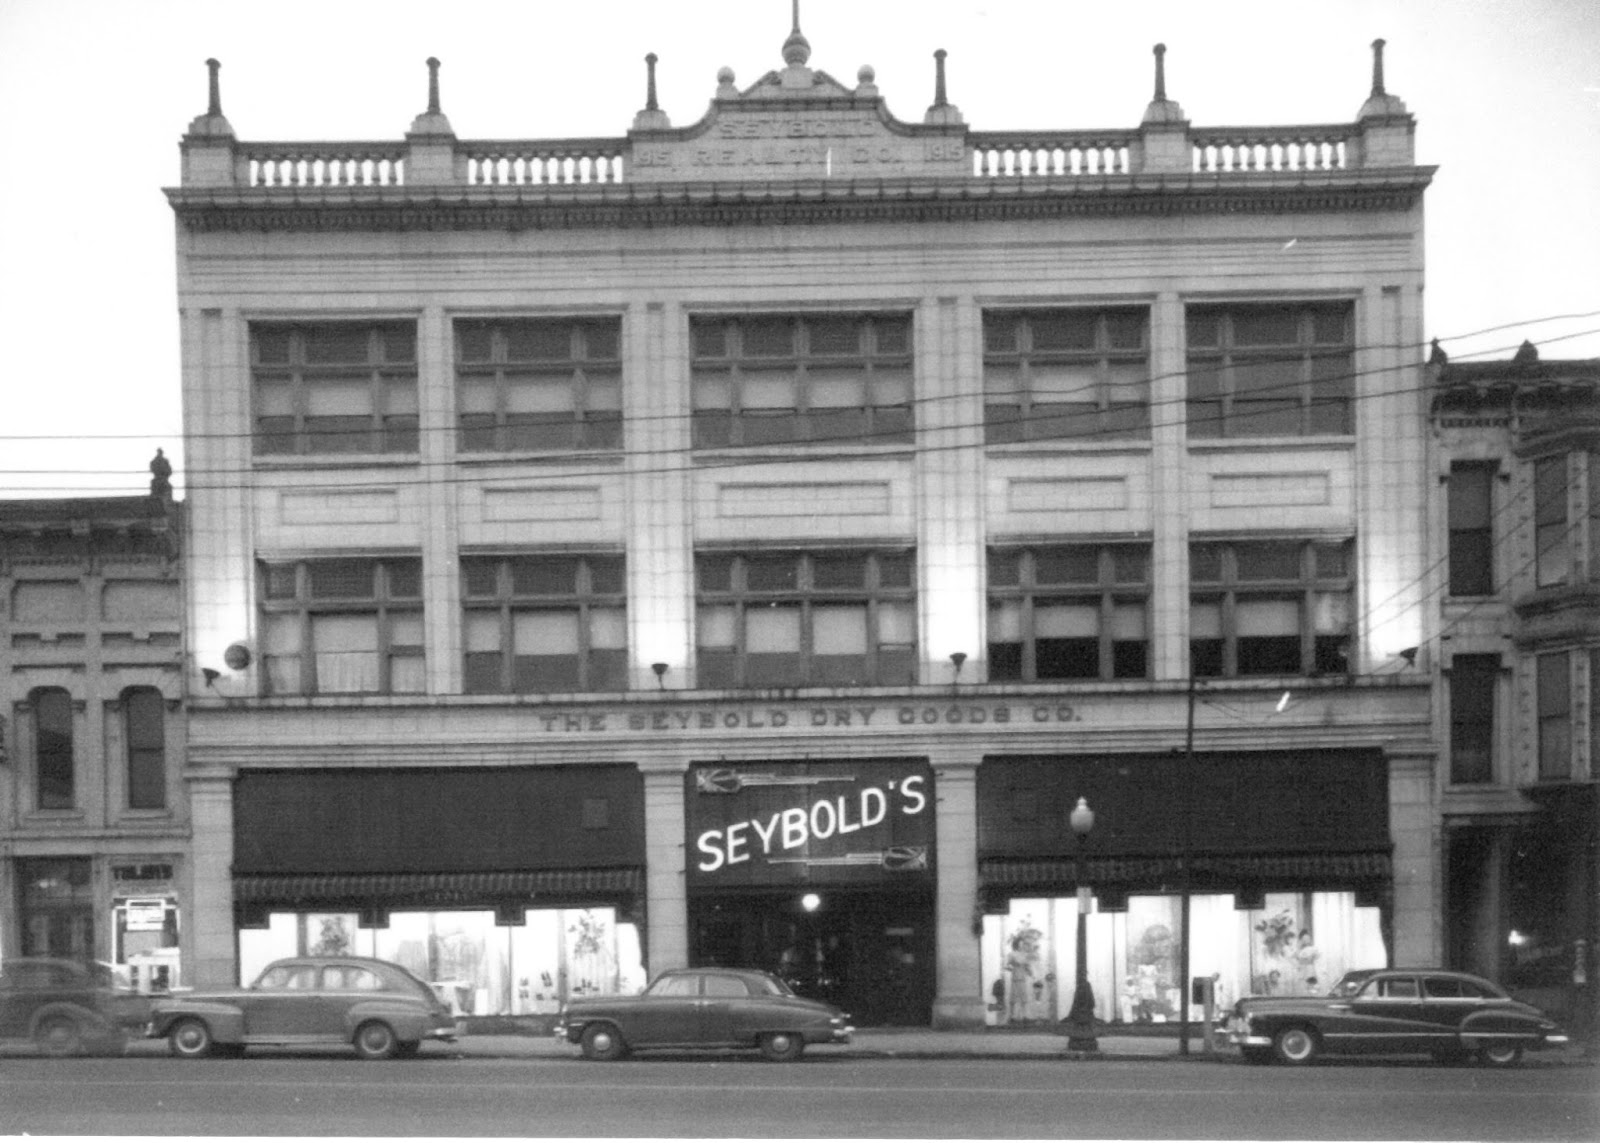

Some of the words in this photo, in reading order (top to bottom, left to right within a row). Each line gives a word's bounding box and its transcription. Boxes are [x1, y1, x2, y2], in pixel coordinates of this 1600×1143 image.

[539, 713, 606, 732] THE
[628, 710, 789, 731] SEYBOLD
[811, 707, 877, 726] DRY
[899, 704, 1011, 725] GOODS
[1033, 704, 1082, 723] CO.
[697, 775, 926, 872] SEYBOLD'S
